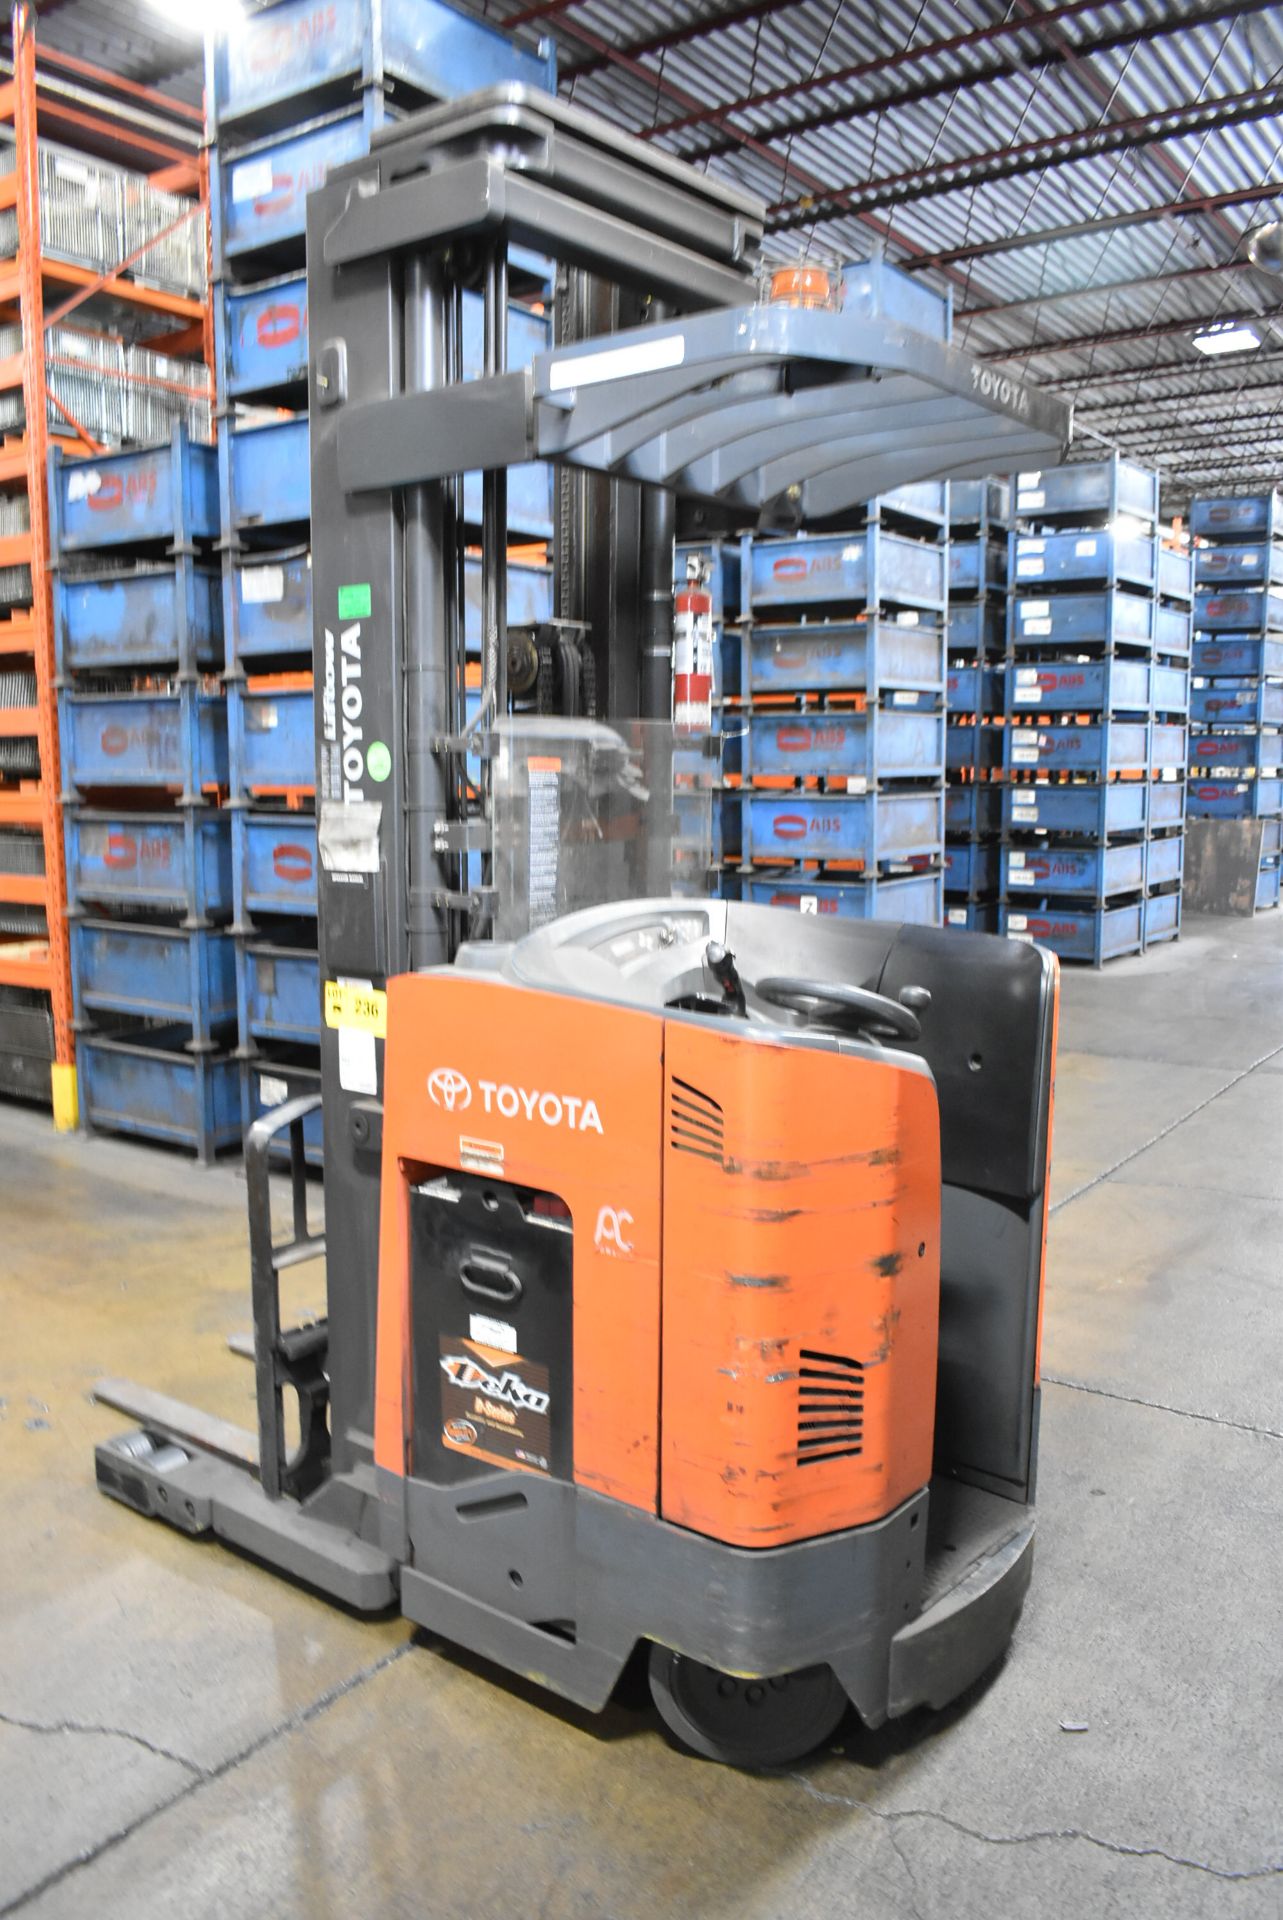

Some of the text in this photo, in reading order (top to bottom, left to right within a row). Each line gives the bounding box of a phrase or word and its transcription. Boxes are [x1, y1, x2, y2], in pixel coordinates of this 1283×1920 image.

[971, 364, 1029, 417] TOYOTA
[341, 622, 364, 805] TOYOTA
[478, 1080, 604, 1135] TOYOTA
[594, 1205, 634, 1252] AC
[439, 1355, 550, 1414] Deka
